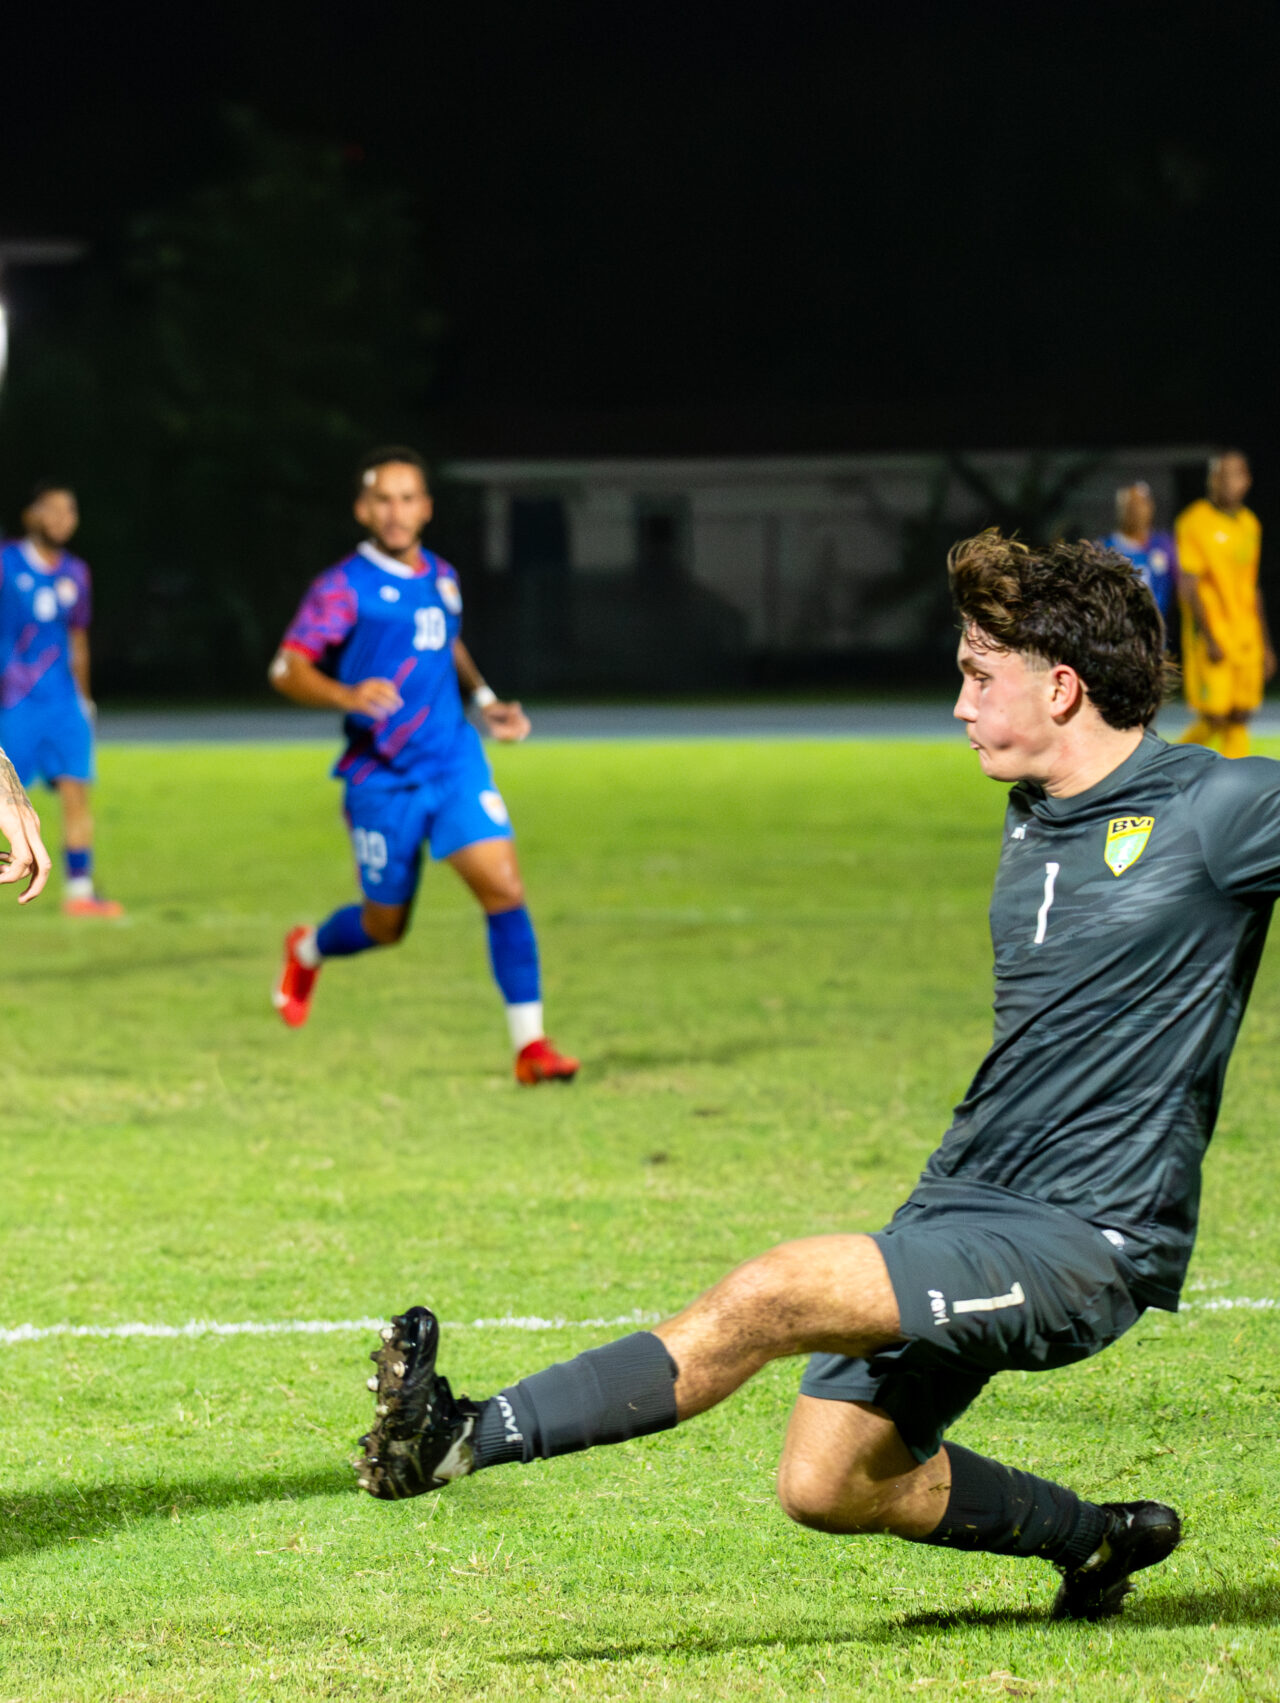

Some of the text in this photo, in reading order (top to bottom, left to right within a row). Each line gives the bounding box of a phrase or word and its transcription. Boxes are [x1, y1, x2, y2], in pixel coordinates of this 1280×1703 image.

[1111, 818, 1152, 834] BVI
[1034, 862, 1060, 944] 1
[952, 1281, 1026, 1314] 1
